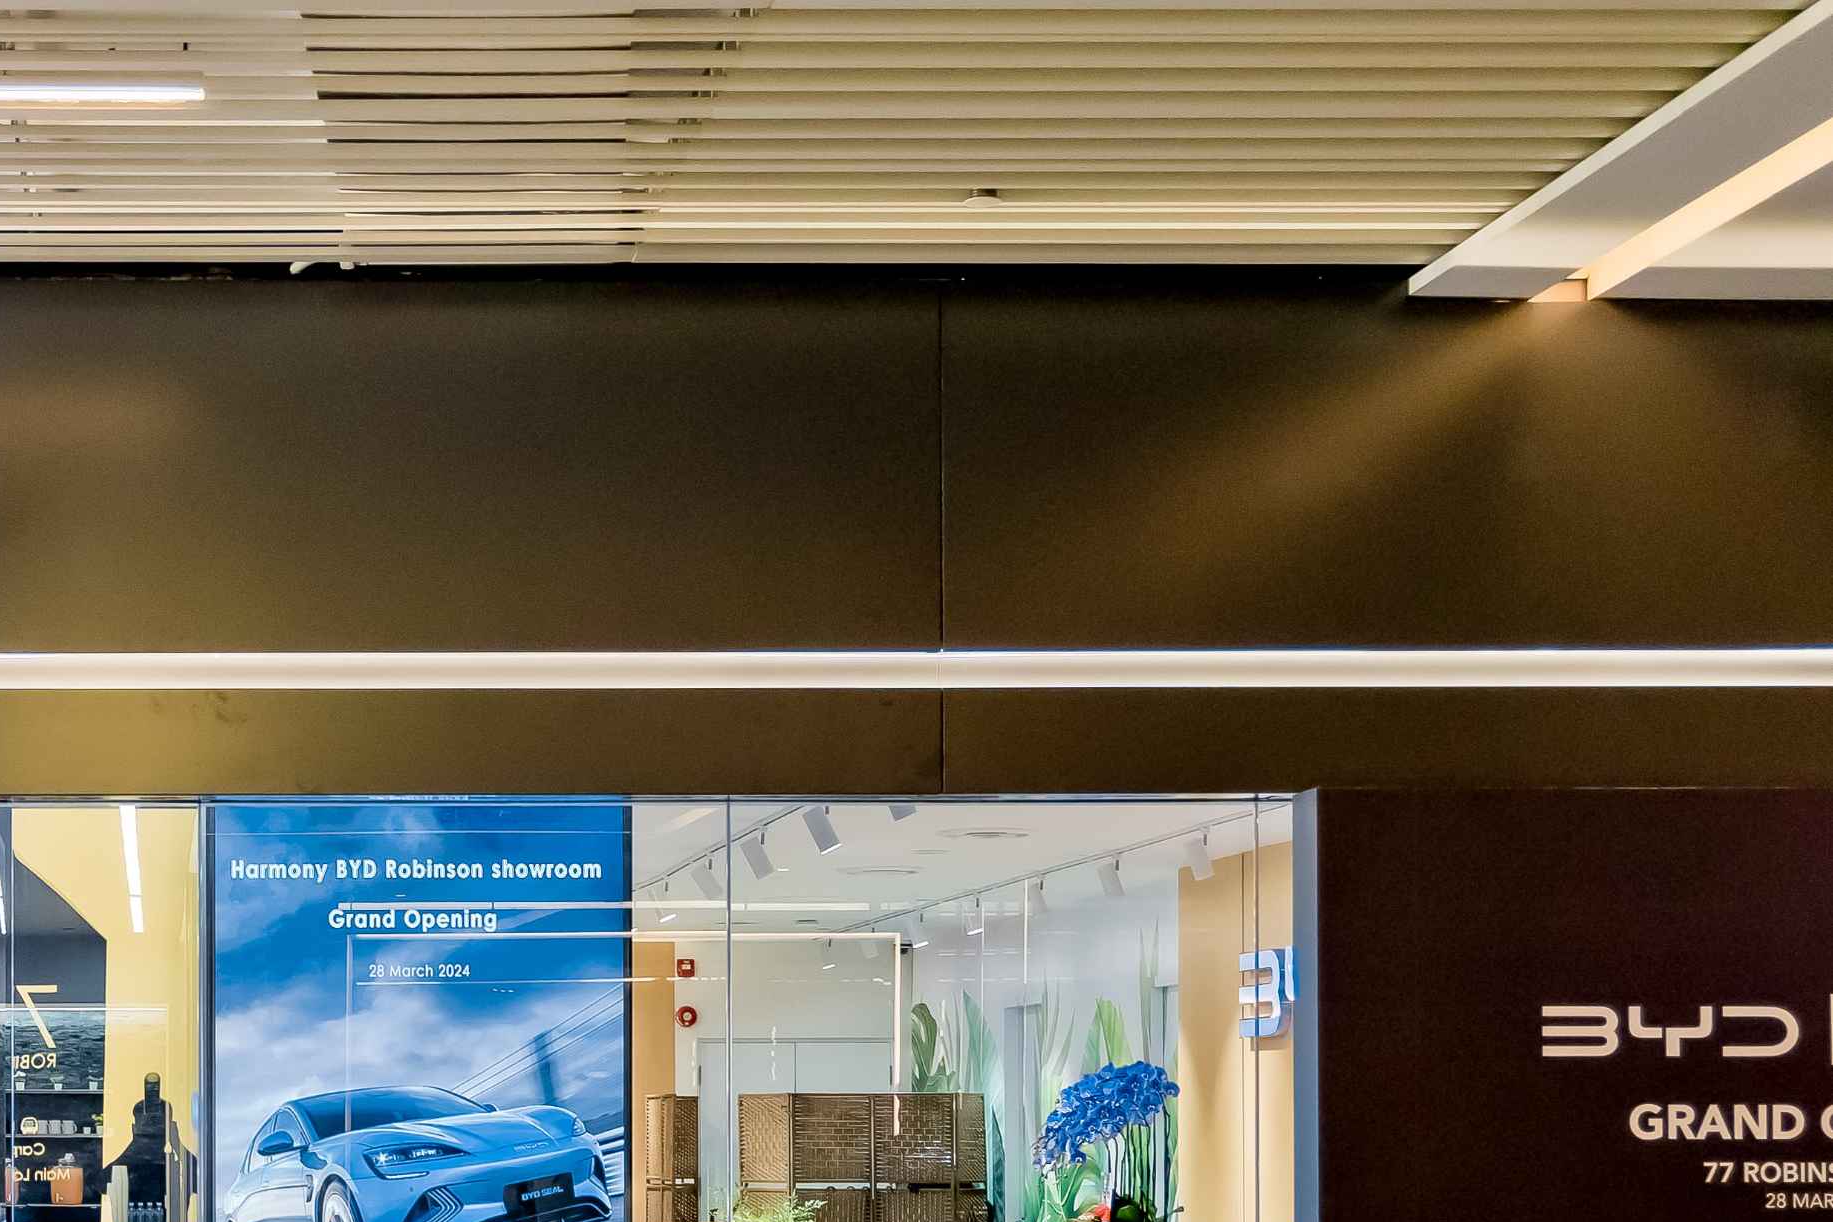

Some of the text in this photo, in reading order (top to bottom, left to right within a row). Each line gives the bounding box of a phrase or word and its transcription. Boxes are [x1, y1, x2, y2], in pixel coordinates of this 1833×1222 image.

[230, 859, 602, 883] Harmony BYD Robinson showroom
[328, 909, 498, 932] Grand Opening
[369, 964, 471, 978] 28 March 2024
[1541, 1005, 1800, 1058] BYD
[1629, 1103, 1806, 1141] GRAND
[1703, 1161, 1735, 1184] 77
[1765, 1192, 1833, 1209] 28 MAR
